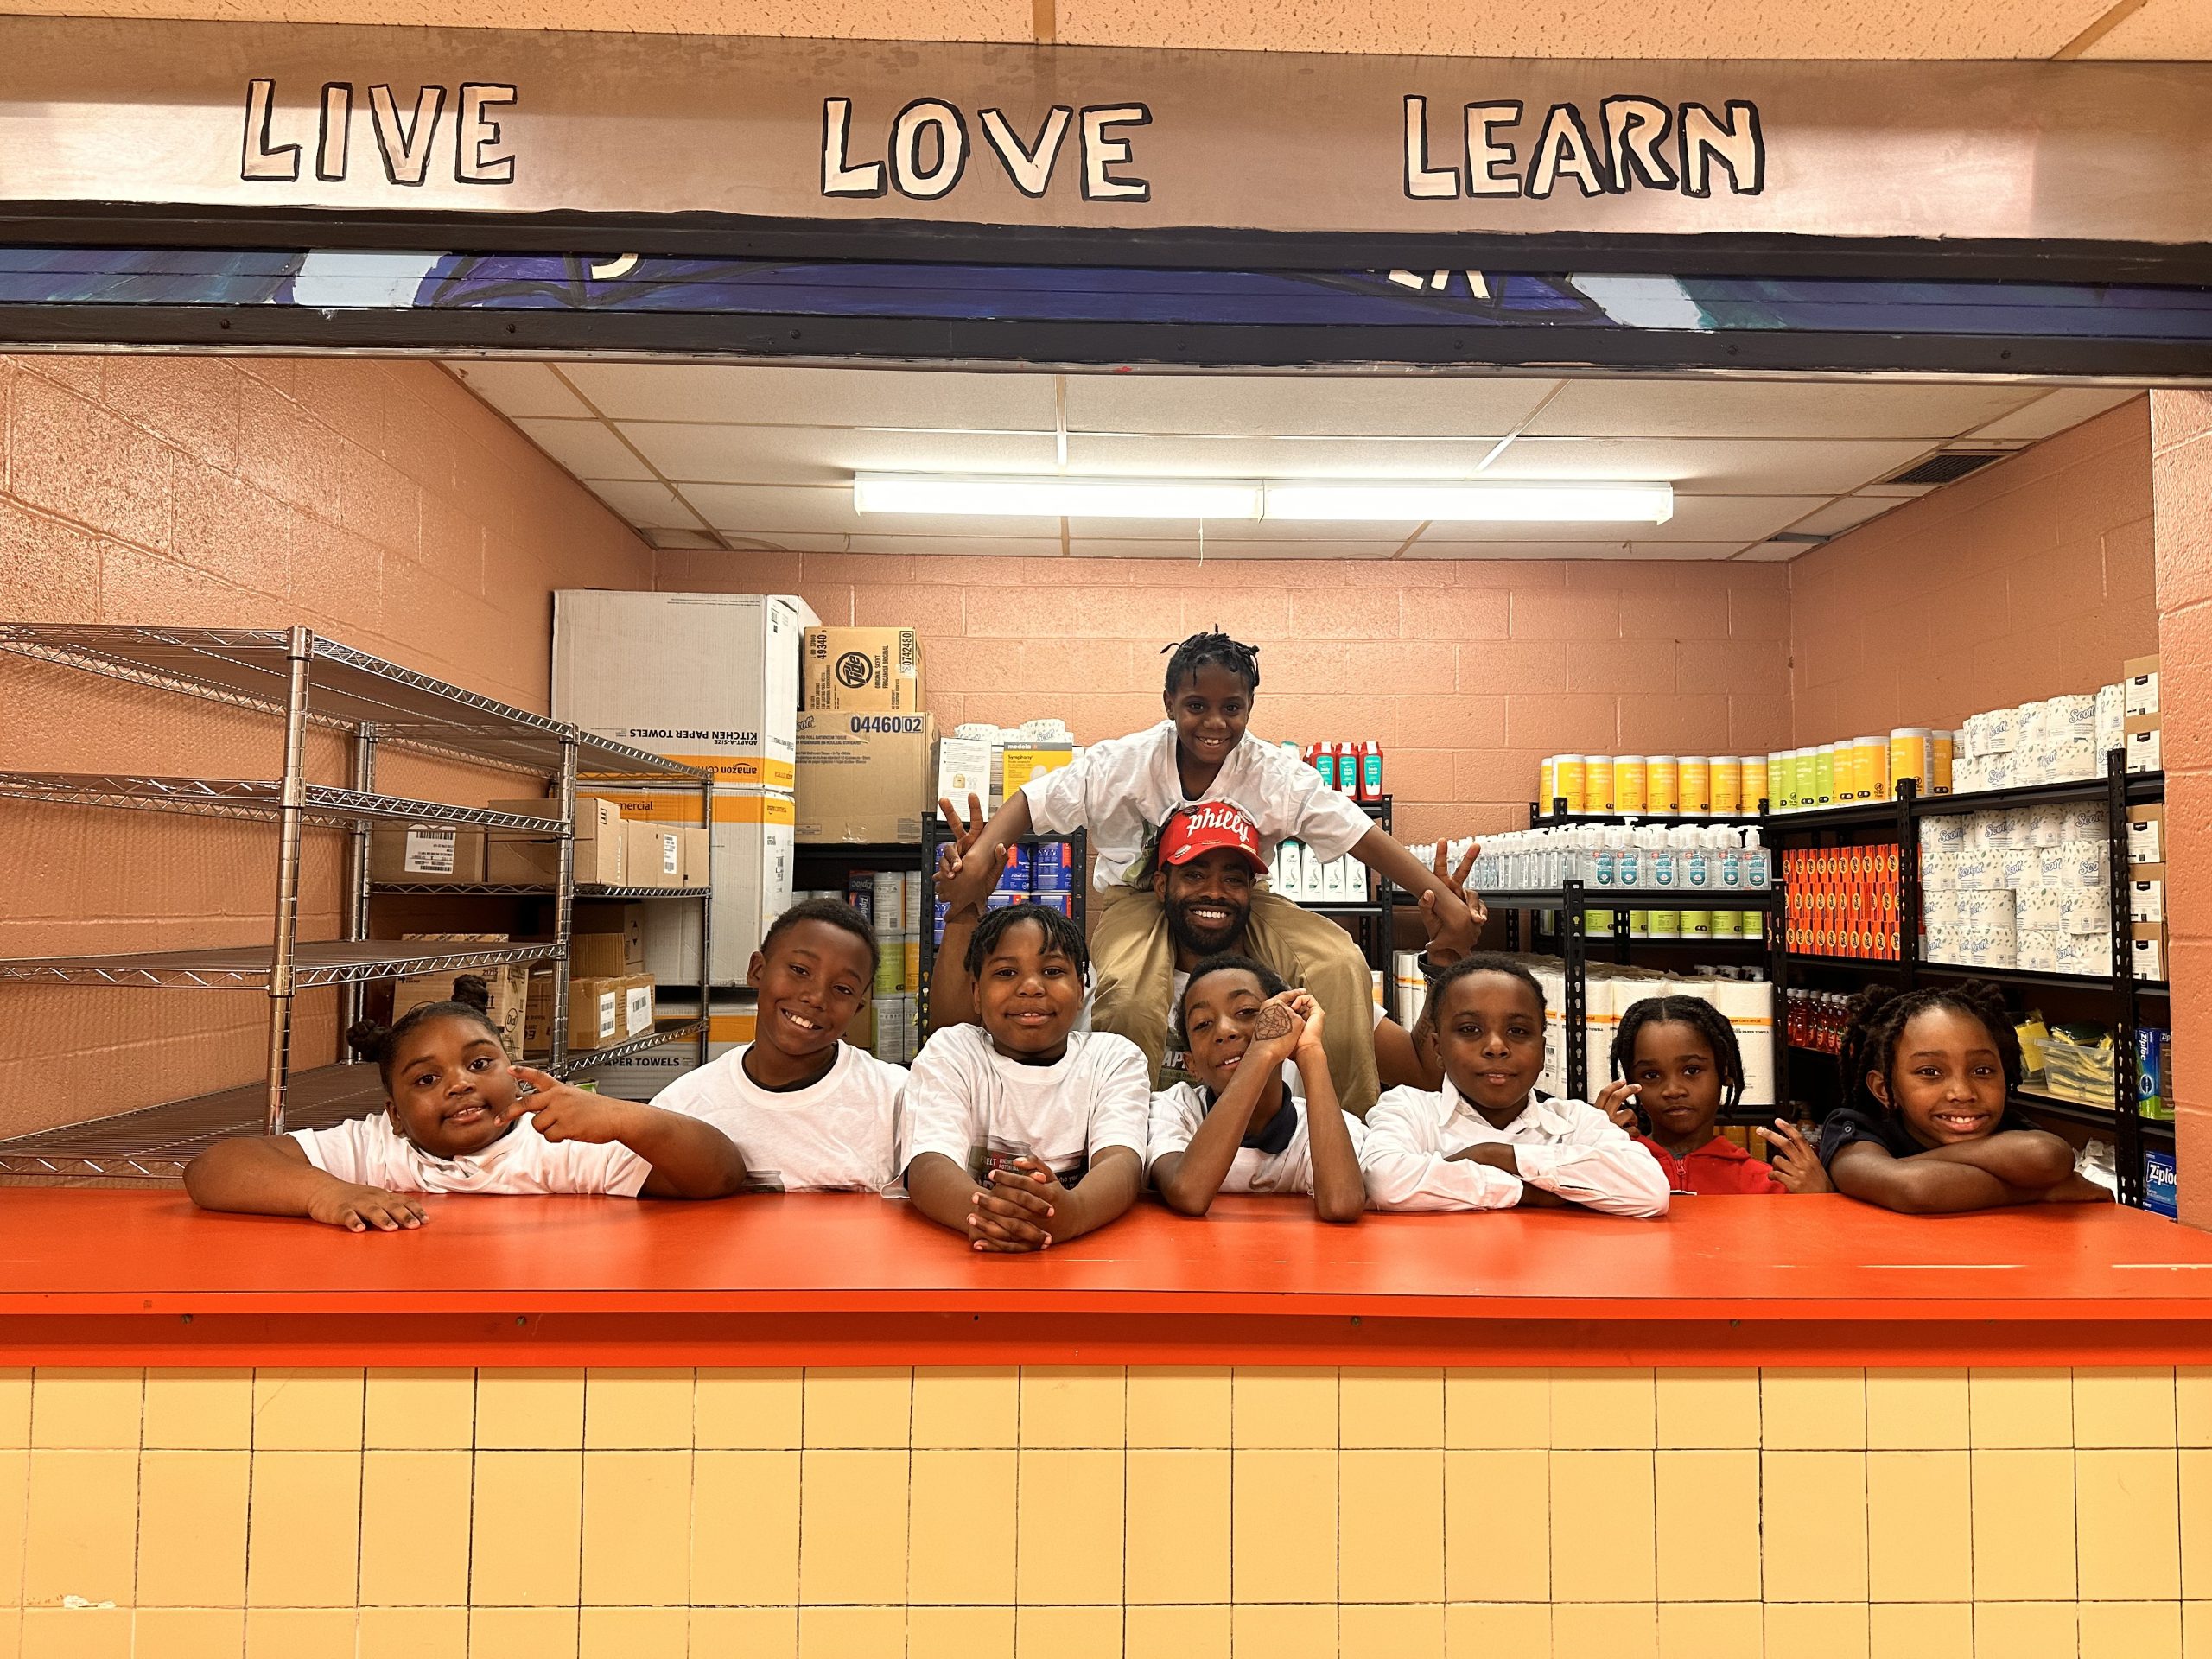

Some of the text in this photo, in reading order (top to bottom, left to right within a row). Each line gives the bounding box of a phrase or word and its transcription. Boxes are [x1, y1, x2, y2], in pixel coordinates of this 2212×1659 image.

[242, 78, 1765, 201] LIVE LOVE LEARN
[817, 634, 827, 659] 49340
[843, 654, 867, 686] Tide
[2069, 705, 2096, 723] Scott
[797, 715, 816, 732] cott
[850, 716, 902, 733] 04460
[904, 718, 922, 732] 02
[629, 728, 672, 738] TOWELS
[676, 730, 709, 739] PAPER
[712, 731, 758, 740] KITCHEN
[721, 766, 758, 775] amazon
[619, 801, 654, 810] mercial
[1186, 807, 1250, 843] philly
[2079, 861, 2099, 875] Sco
[2161, 1033, 2171, 1042] Zip
[2139, 1033, 2147, 1061] Ziploc
[635, 1058, 680, 1066] TOWELS
